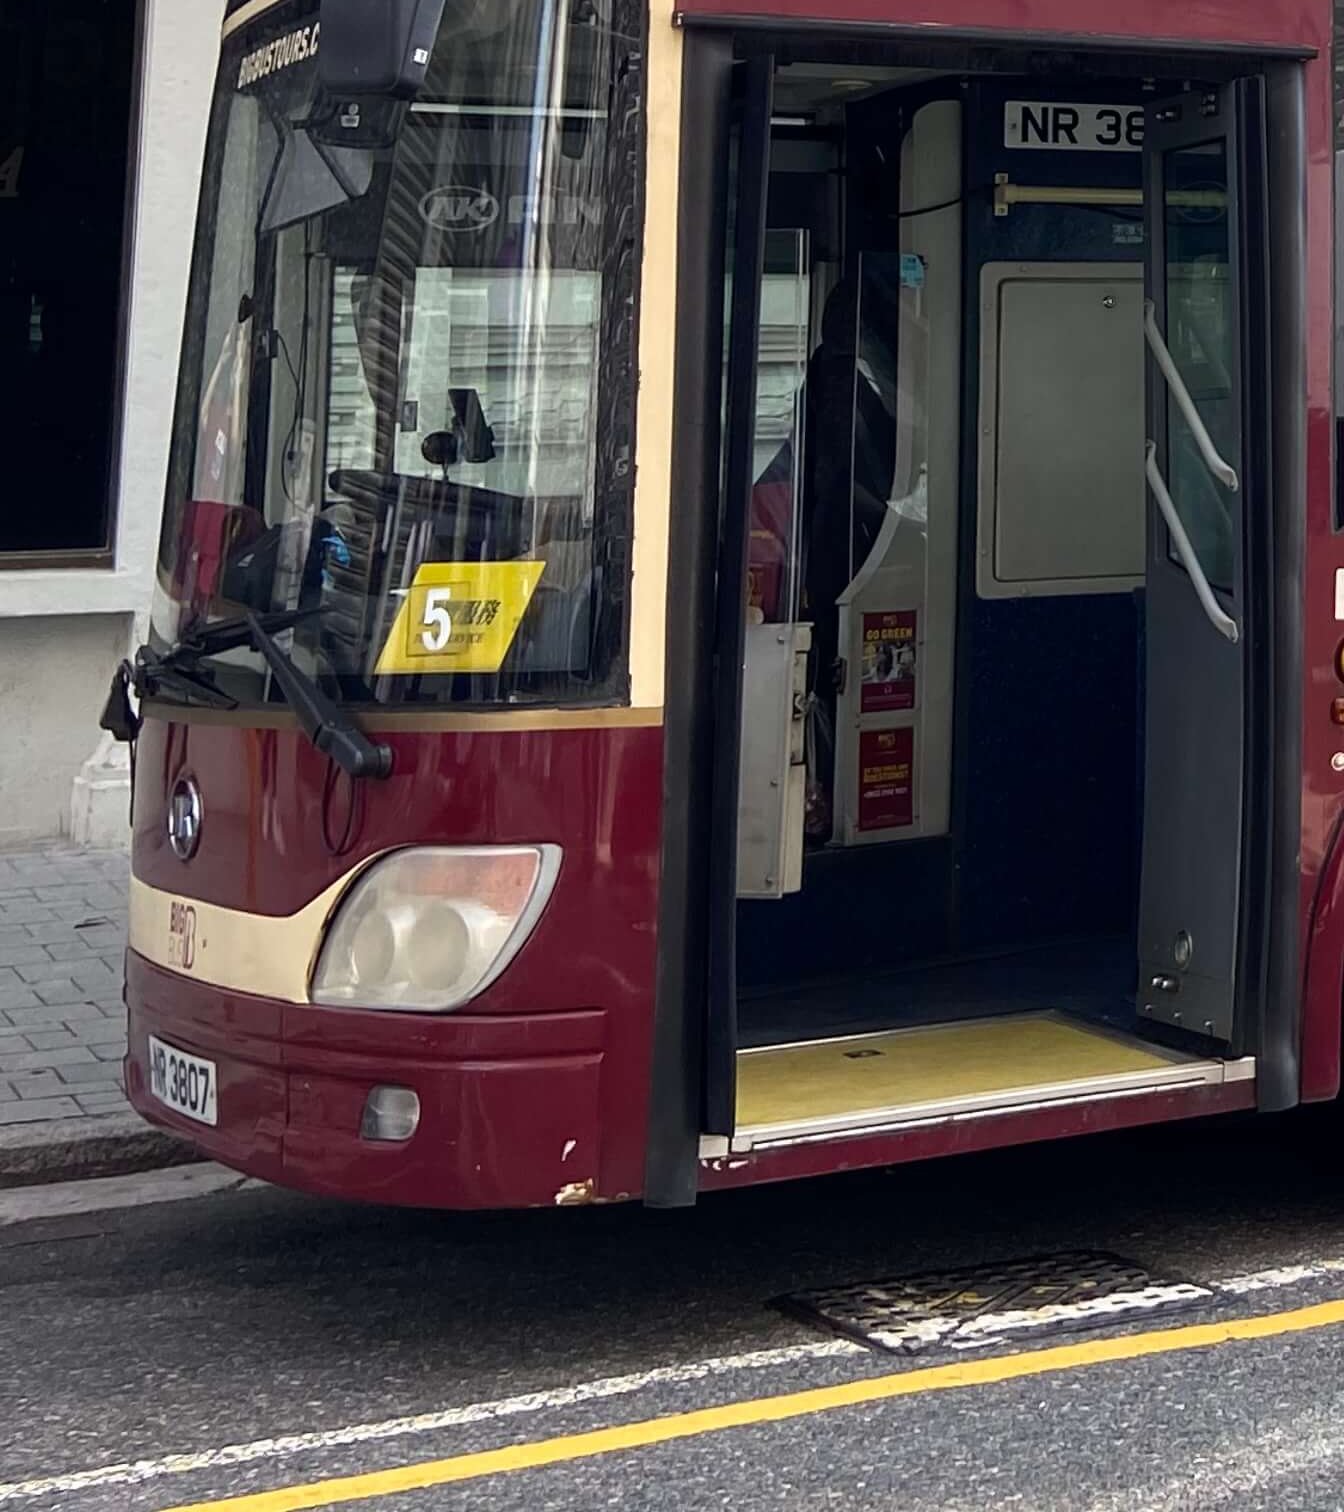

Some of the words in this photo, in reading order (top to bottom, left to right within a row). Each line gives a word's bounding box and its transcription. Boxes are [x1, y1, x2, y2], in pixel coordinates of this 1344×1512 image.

[1020, 106, 1080, 145] NR
[421, 587, 452, 651] 5
[169, 1055, 210, 1116] 3807
